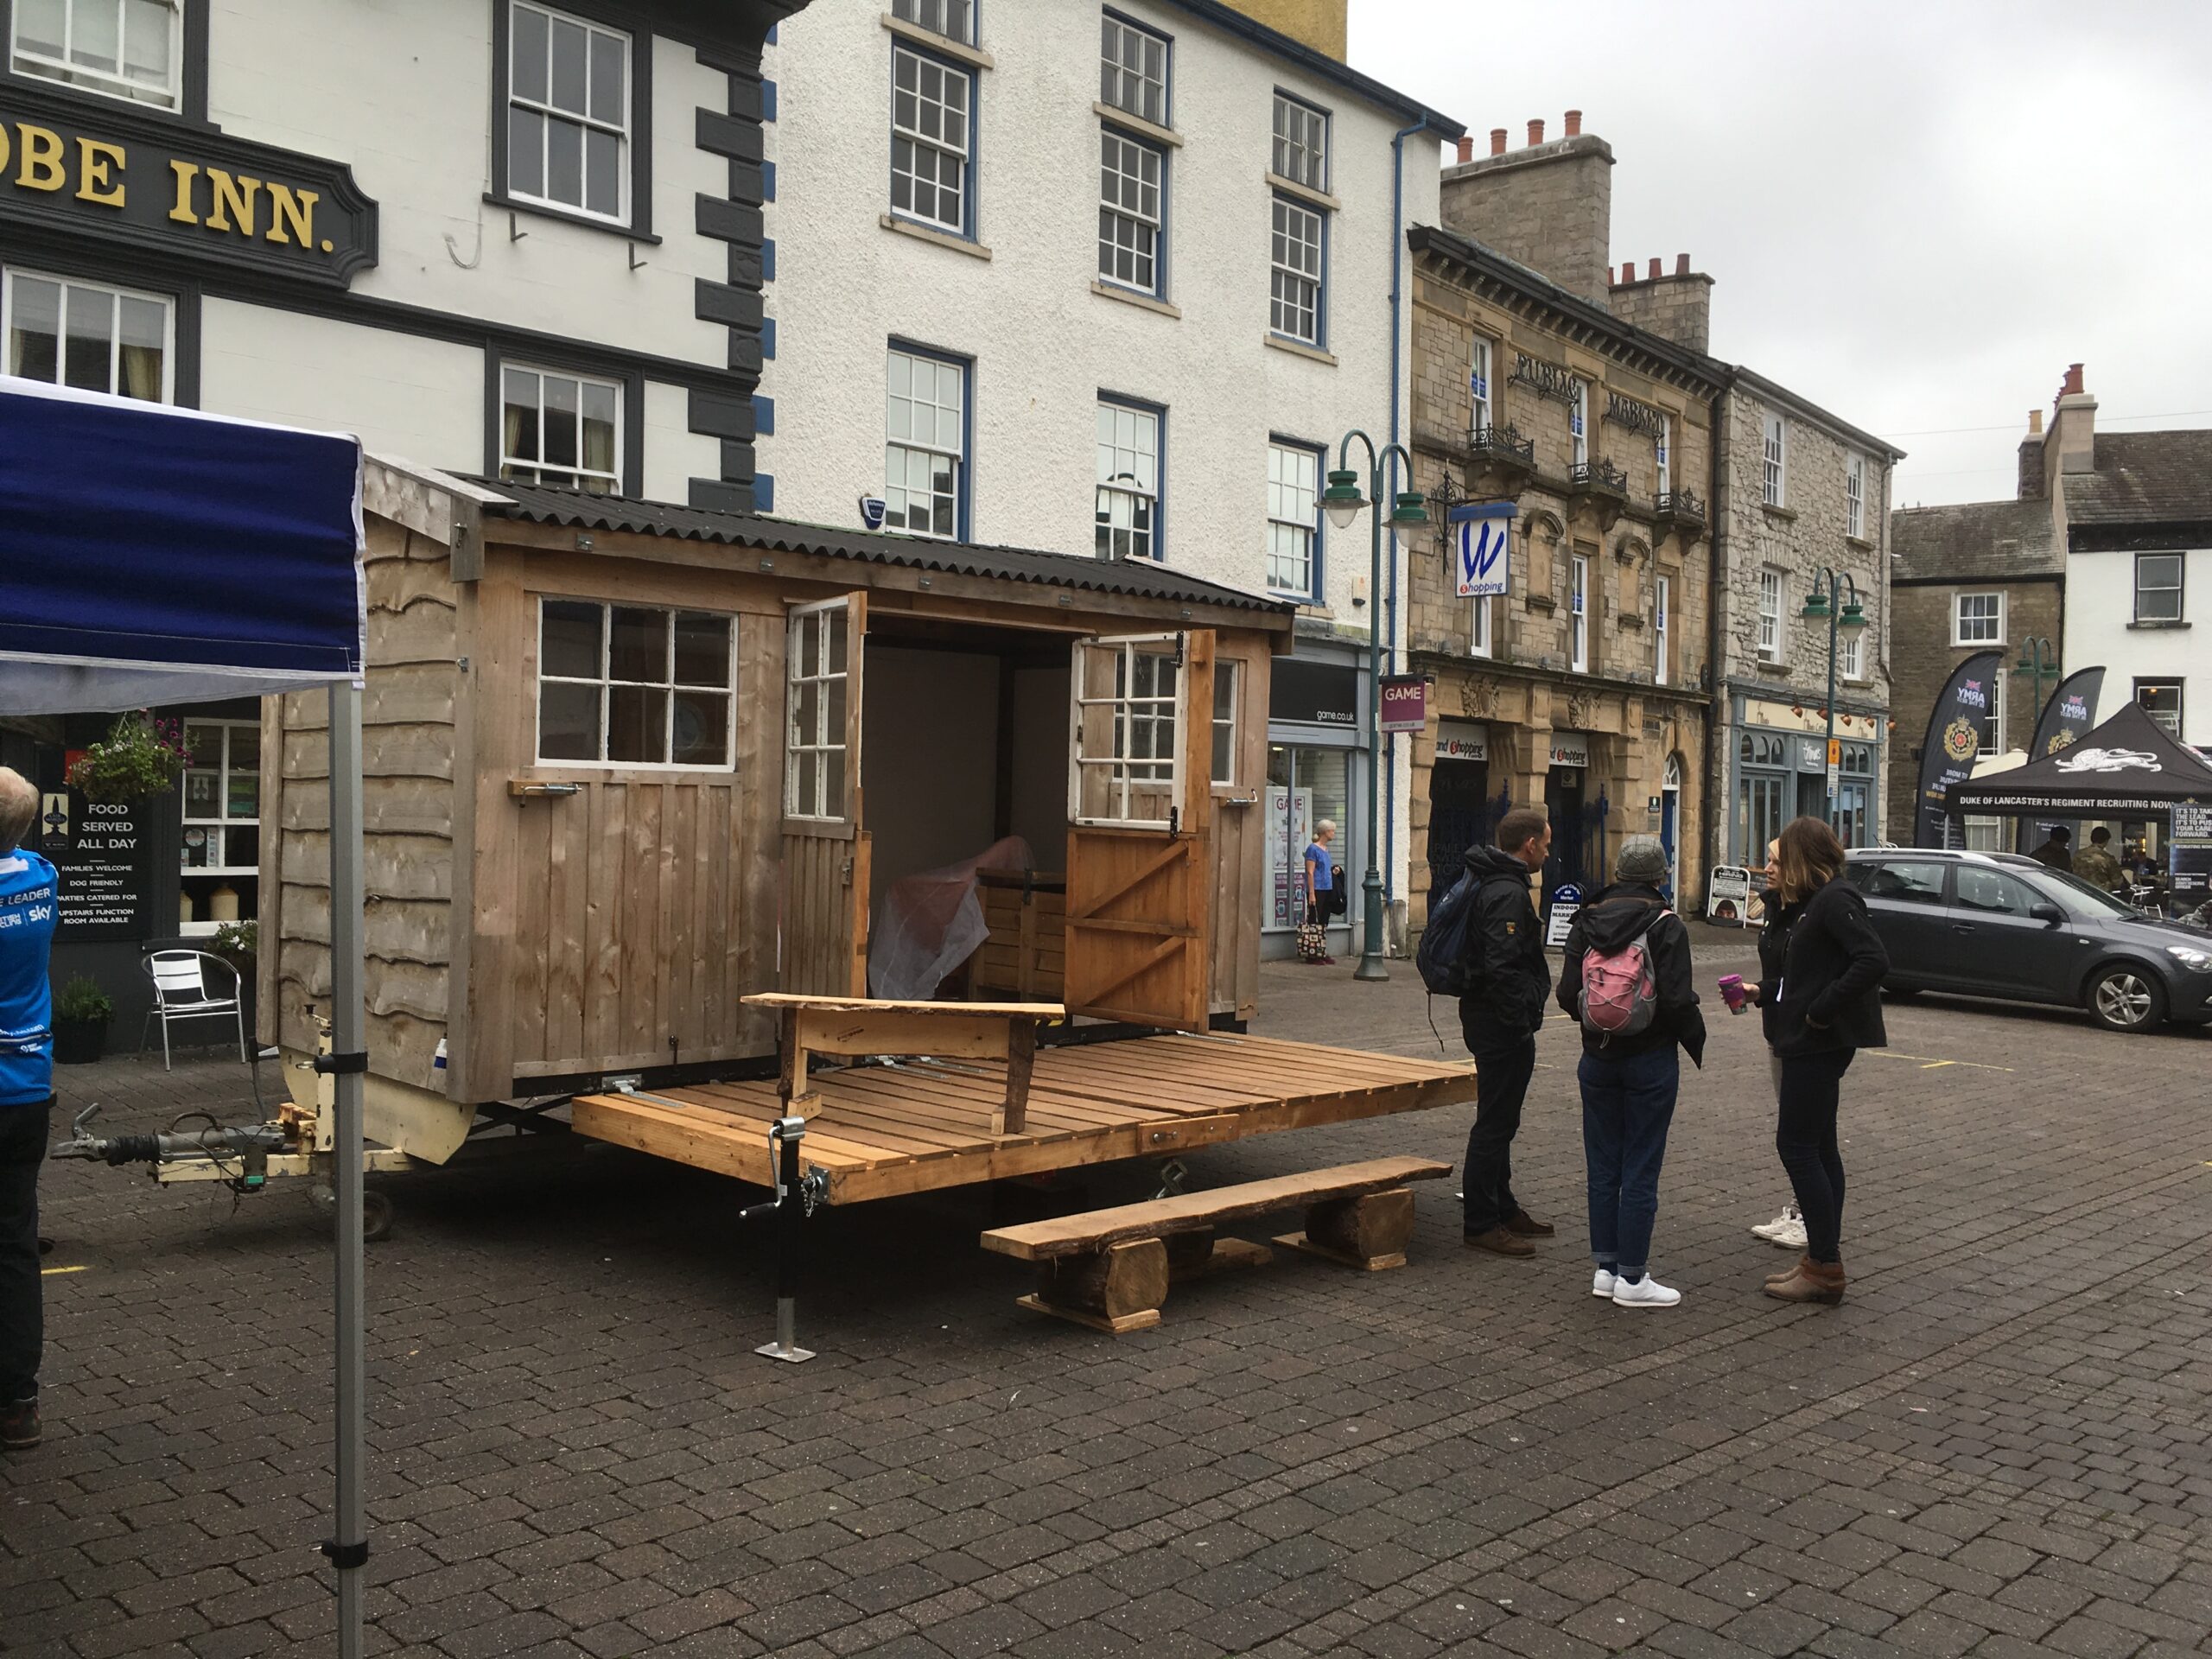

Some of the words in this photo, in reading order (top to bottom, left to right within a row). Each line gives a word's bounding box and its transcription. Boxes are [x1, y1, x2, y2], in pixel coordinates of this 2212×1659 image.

[0, 122, 125, 208] BE
[169, 159, 334, 252] INN.
[1462, 520, 1505, 582] W
[1384, 687, 1421, 701] GAME
[1316, 710, 1354, 721] game.co.uk
[88, 804, 129, 815] FOOD
[1276, 798, 1303, 811] GAE
[1960, 796, 1981, 805] DUKE
[1982, 796, 1993, 805] OF
[1994, 797, 2050, 807] LANCASTER'S
[2051, 798, 2095, 808] REGIMENT
[2096, 798, 2149, 809] RECRUITING
[2151, 800, 2172, 810] NOW
[82, 822, 134, 832] SERVED
[77, 838, 105, 849] ALL
[108, 838, 137, 849] DAY
[8, 887, 51, 906] LEADER
[29, 905, 52, 922] sky
